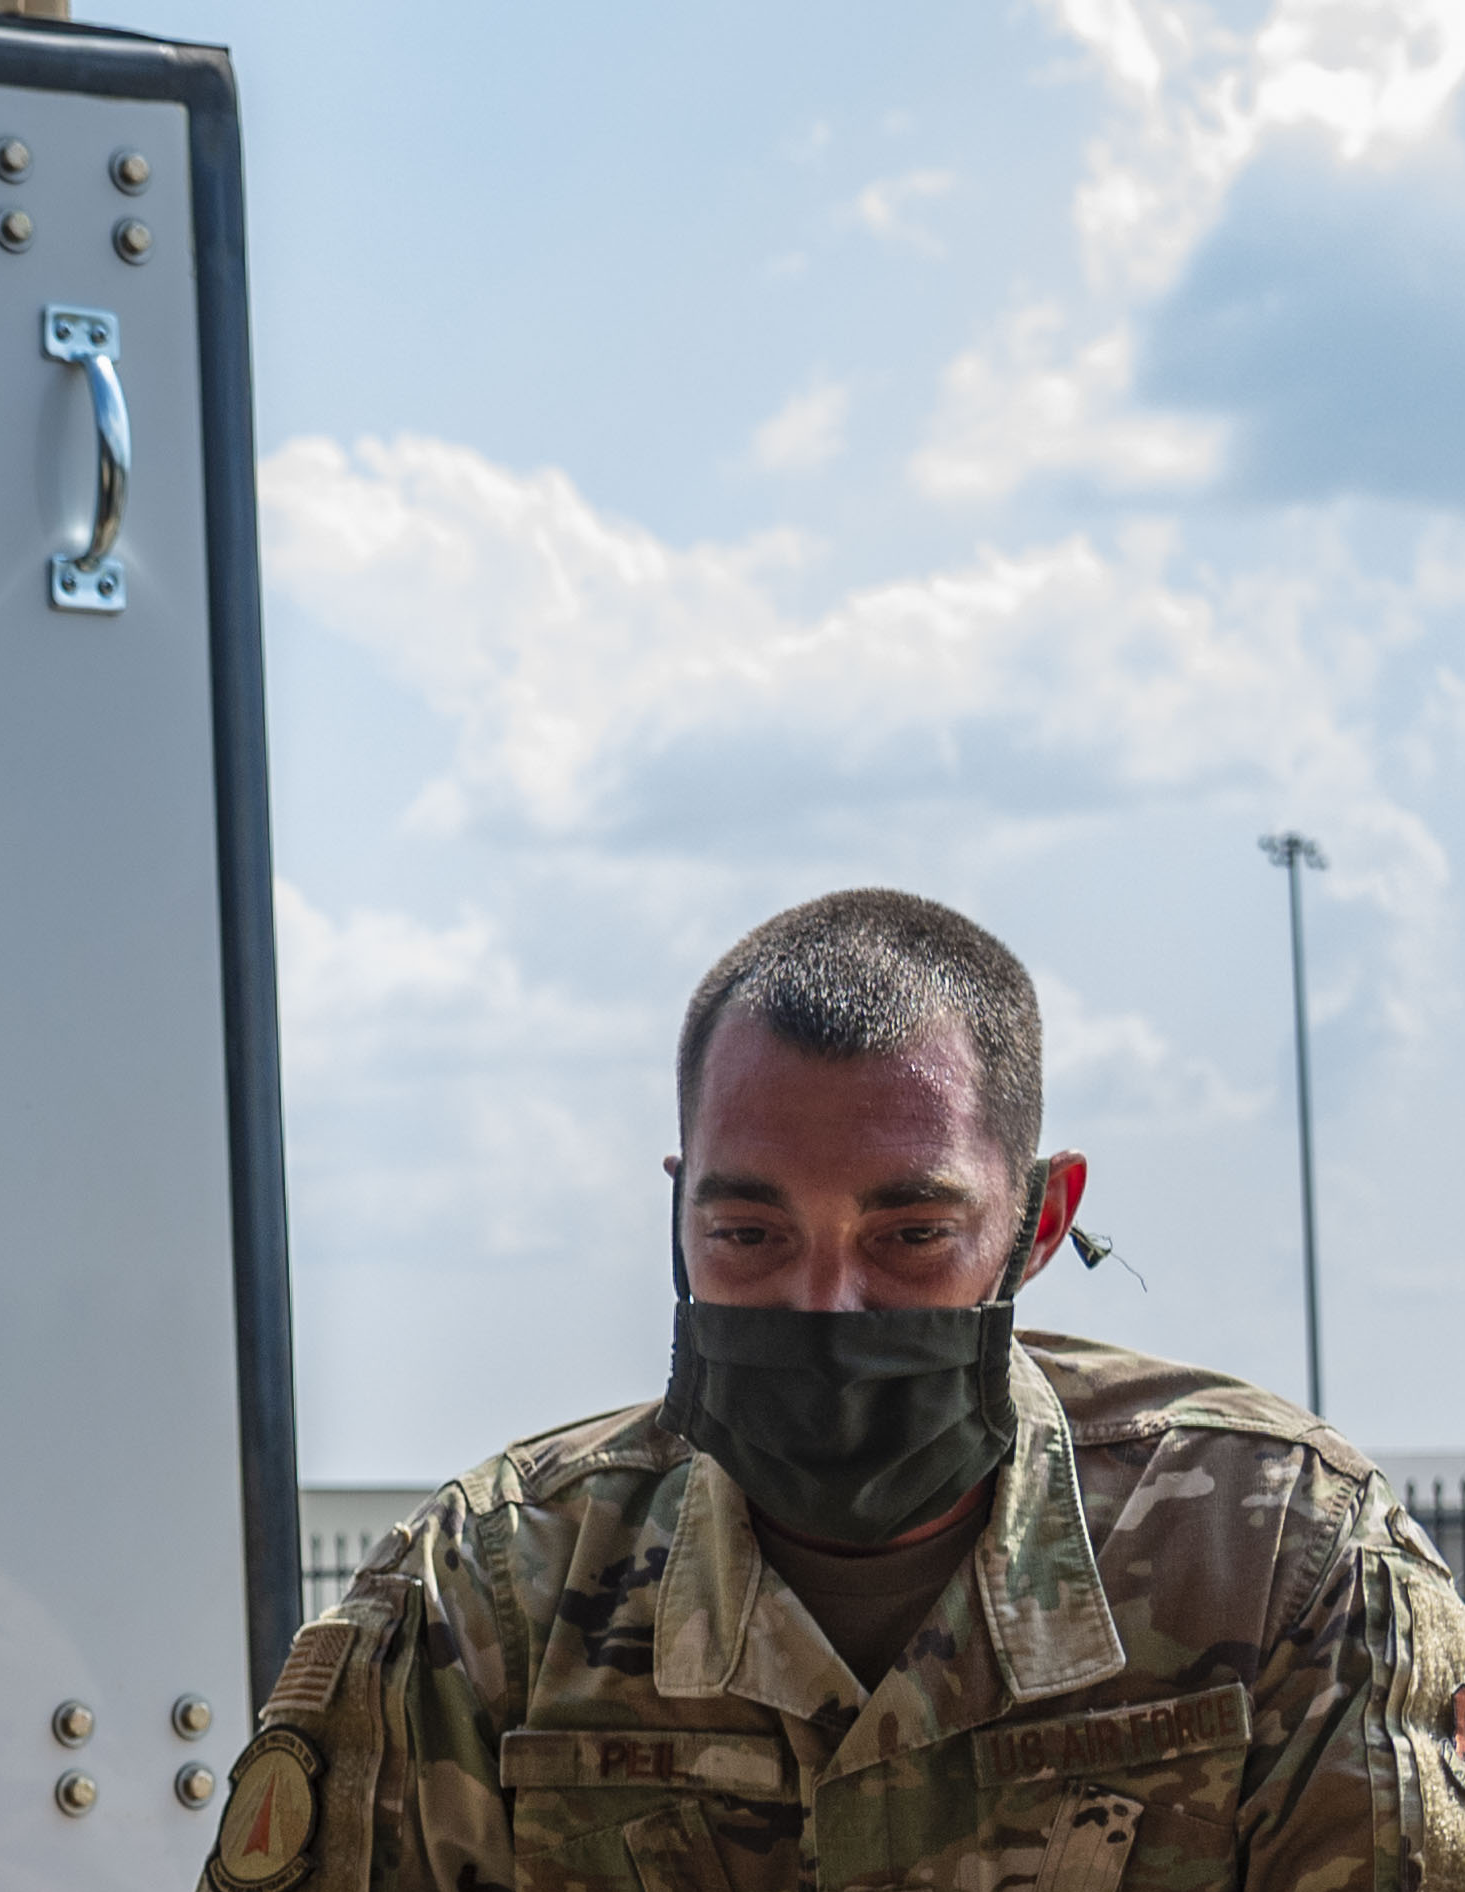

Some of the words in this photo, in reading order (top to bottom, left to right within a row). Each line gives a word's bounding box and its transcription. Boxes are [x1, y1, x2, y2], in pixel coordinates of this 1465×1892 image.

[992, 1730, 1046, 1778] US
[1062, 1717, 1125, 1769] AIR
[1128, 1693, 1238, 1755] FORCE
